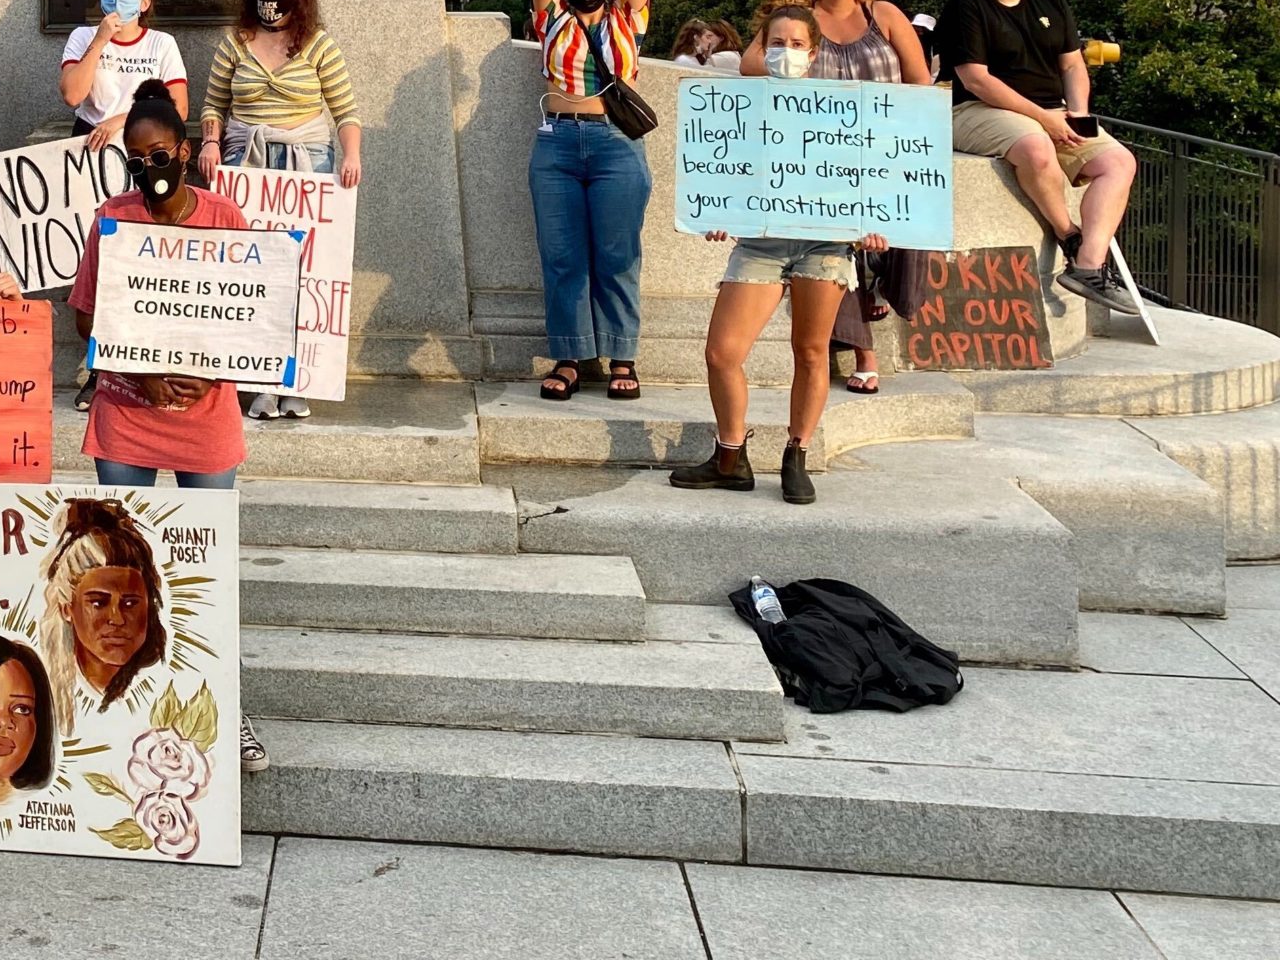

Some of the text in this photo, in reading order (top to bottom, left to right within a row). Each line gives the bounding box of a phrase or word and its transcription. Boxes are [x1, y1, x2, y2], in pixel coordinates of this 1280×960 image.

[116, 57, 157, 67] AMERIC
[117, 65, 153, 75] AGAIN
[689, 84, 894, 128] Stop making it
[685, 119, 934, 159] illegal to protest just
[64, 144, 132, 208] MO
[683, 154, 946, 189] because you disagree with
[217, 170, 334, 224] NO MORE
[687, 193, 733, 218] your
[138, 236, 261, 264] AMERICA
[127, 275, 266, 298] WHERE IS YOUR
[134, 299, 255, 322] CONSCIENCE?
[964, 299, 1041, 330] OUR
[98, 343, 283, 371] WHERE IS The LOVE?
[908, 332, 1053, 368] CAPITOL
[162, 527, 216, 547] ASHANTI
[170, 545, 207, 563] POSEY
[25, 800, 75, 818] ATATIANA
[18, 813, 76, 833] JEFFERSON
